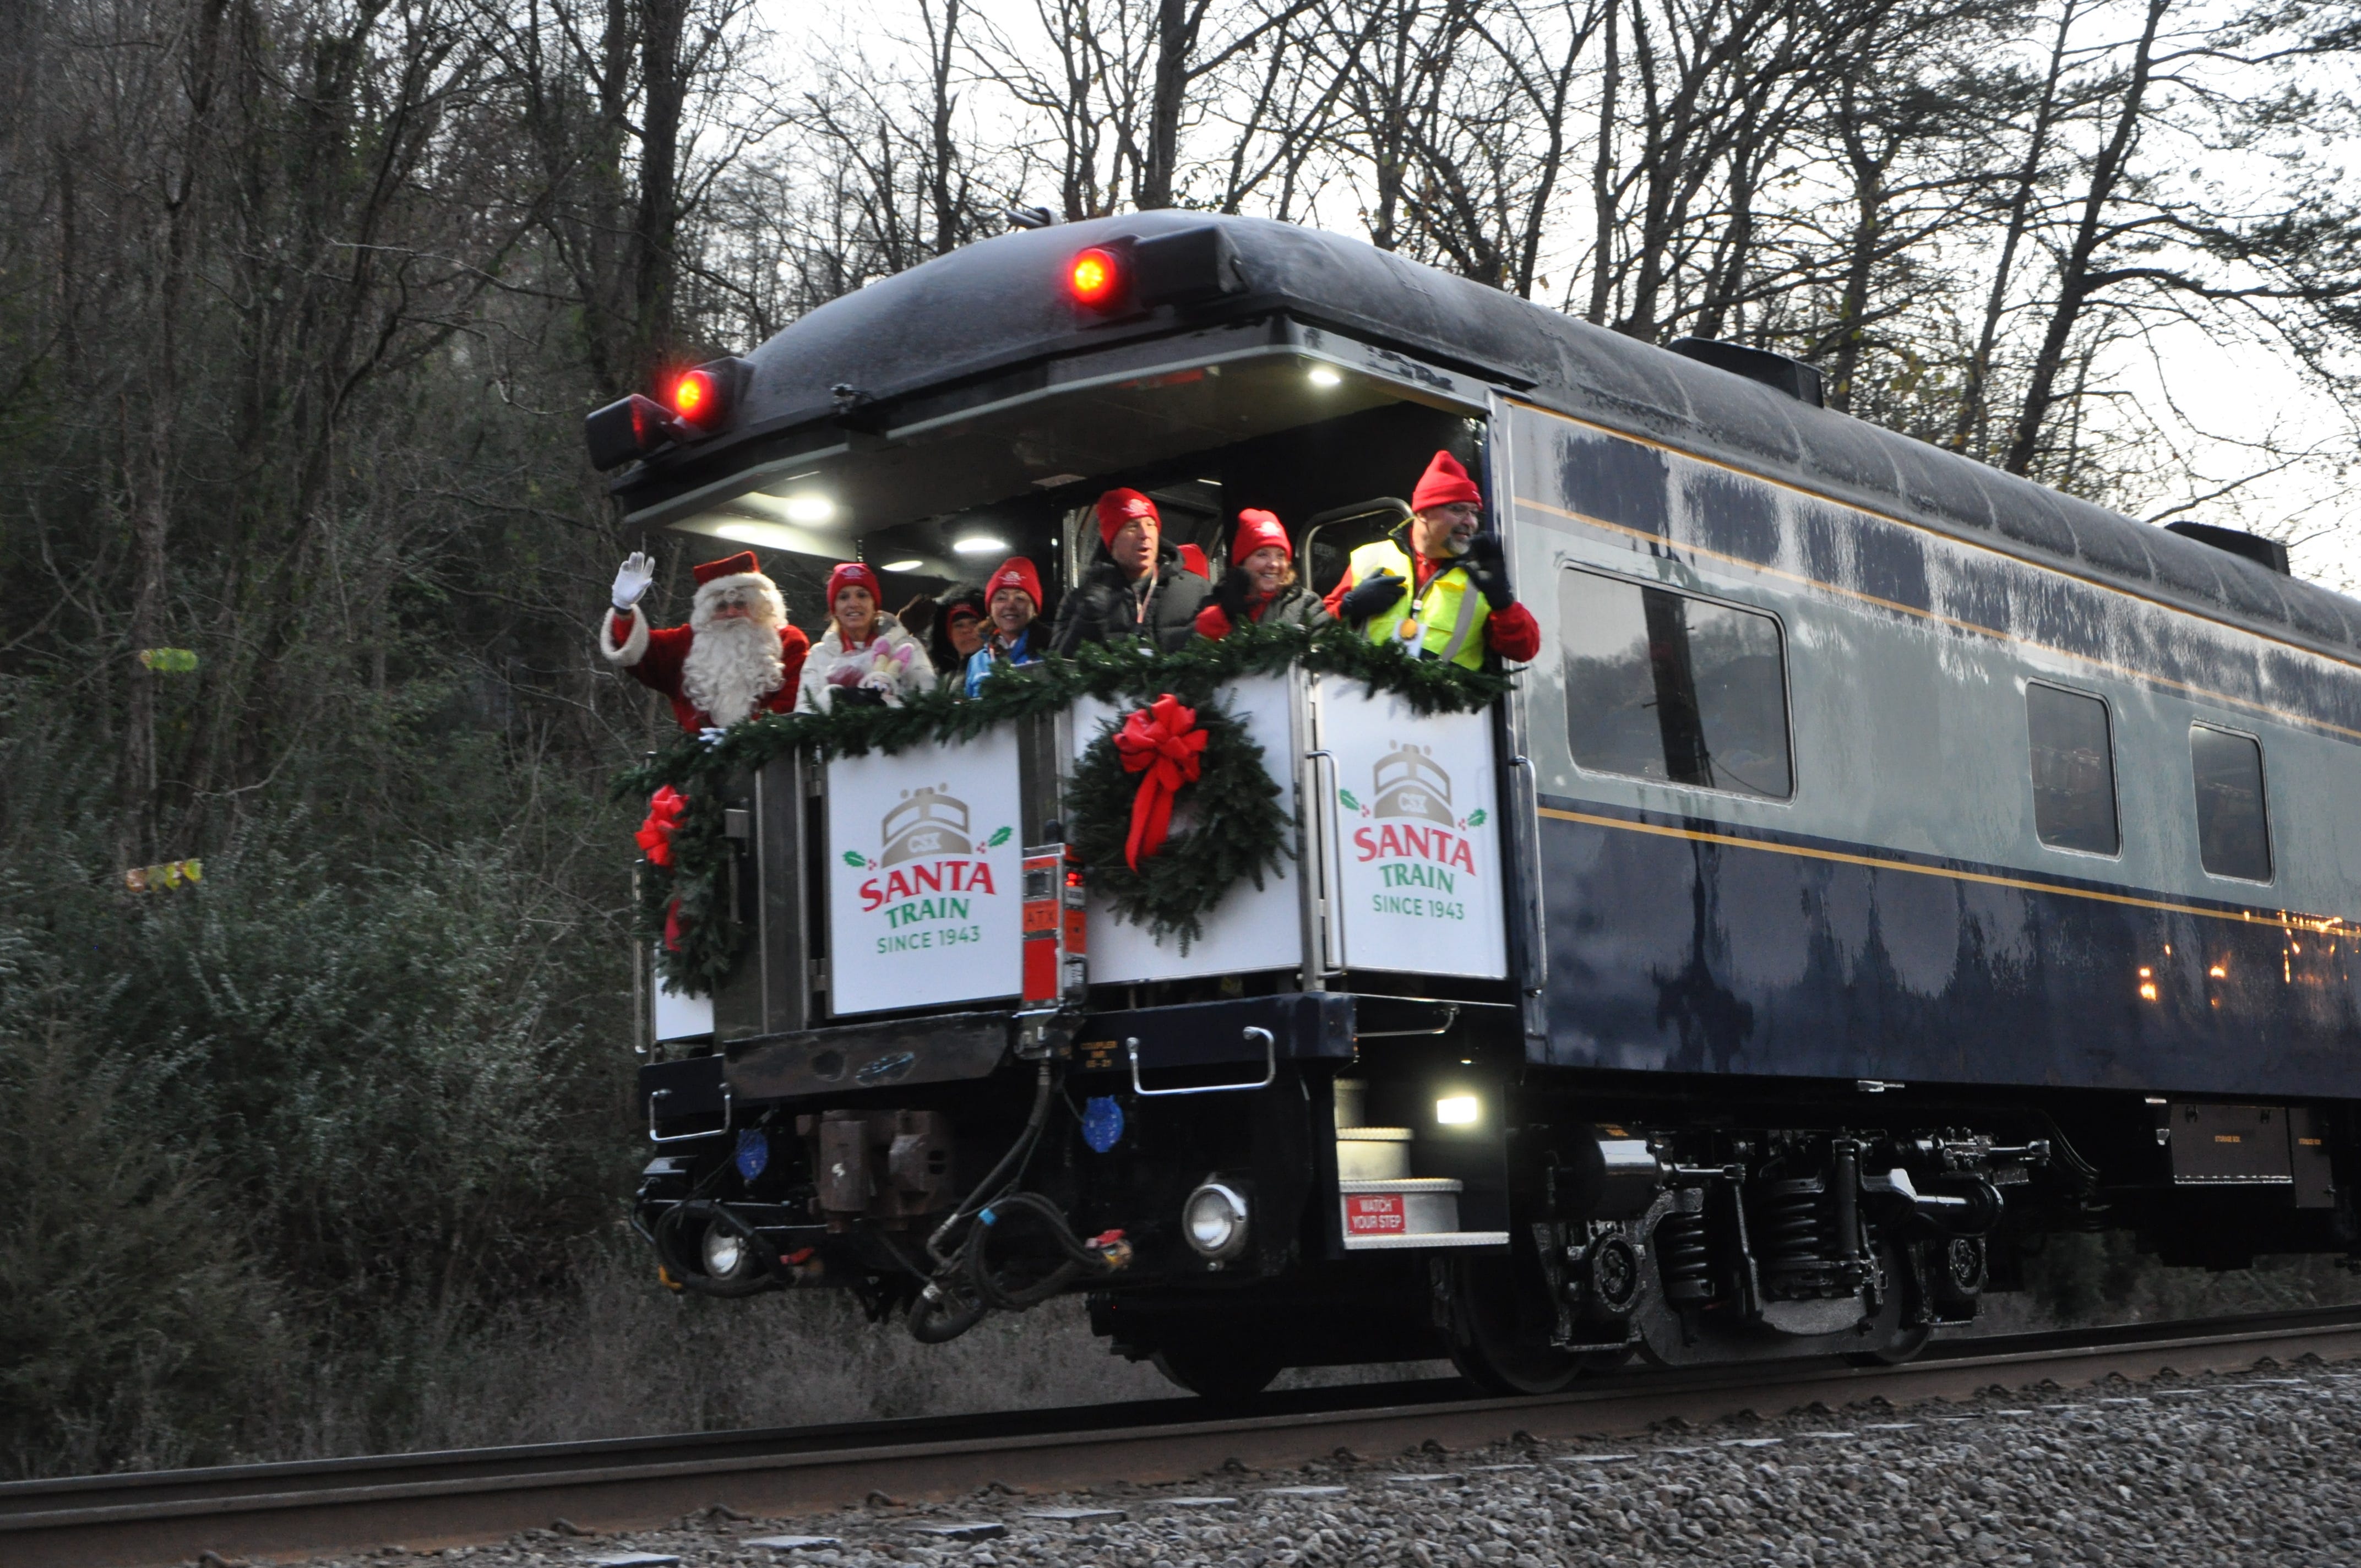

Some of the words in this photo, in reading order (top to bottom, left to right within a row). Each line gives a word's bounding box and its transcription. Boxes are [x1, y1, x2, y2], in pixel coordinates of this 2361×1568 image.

[1398, 792, 1428, 814] CSX
[907, 831, 942, 853] CSX
[1353, 824, 1477, 876] SANTA
[859, 861, 997, 912] SANTA
[1379, 863, 1455, 895] TRAIN
[884, 897, 971, 929] TRAIN
[1373, 894, 1423, 916] SINCE
[1428, 899, 1464, 920] 1943
[877, 932, 932, 954] SINCE
[938, 925, 981, 946] 1943
[1359, 1199, 1392, 1212] WATCH
[1352, 1215, 1378, 1229] YOUR
[1378, 1215, 1401, 1228] STEP
